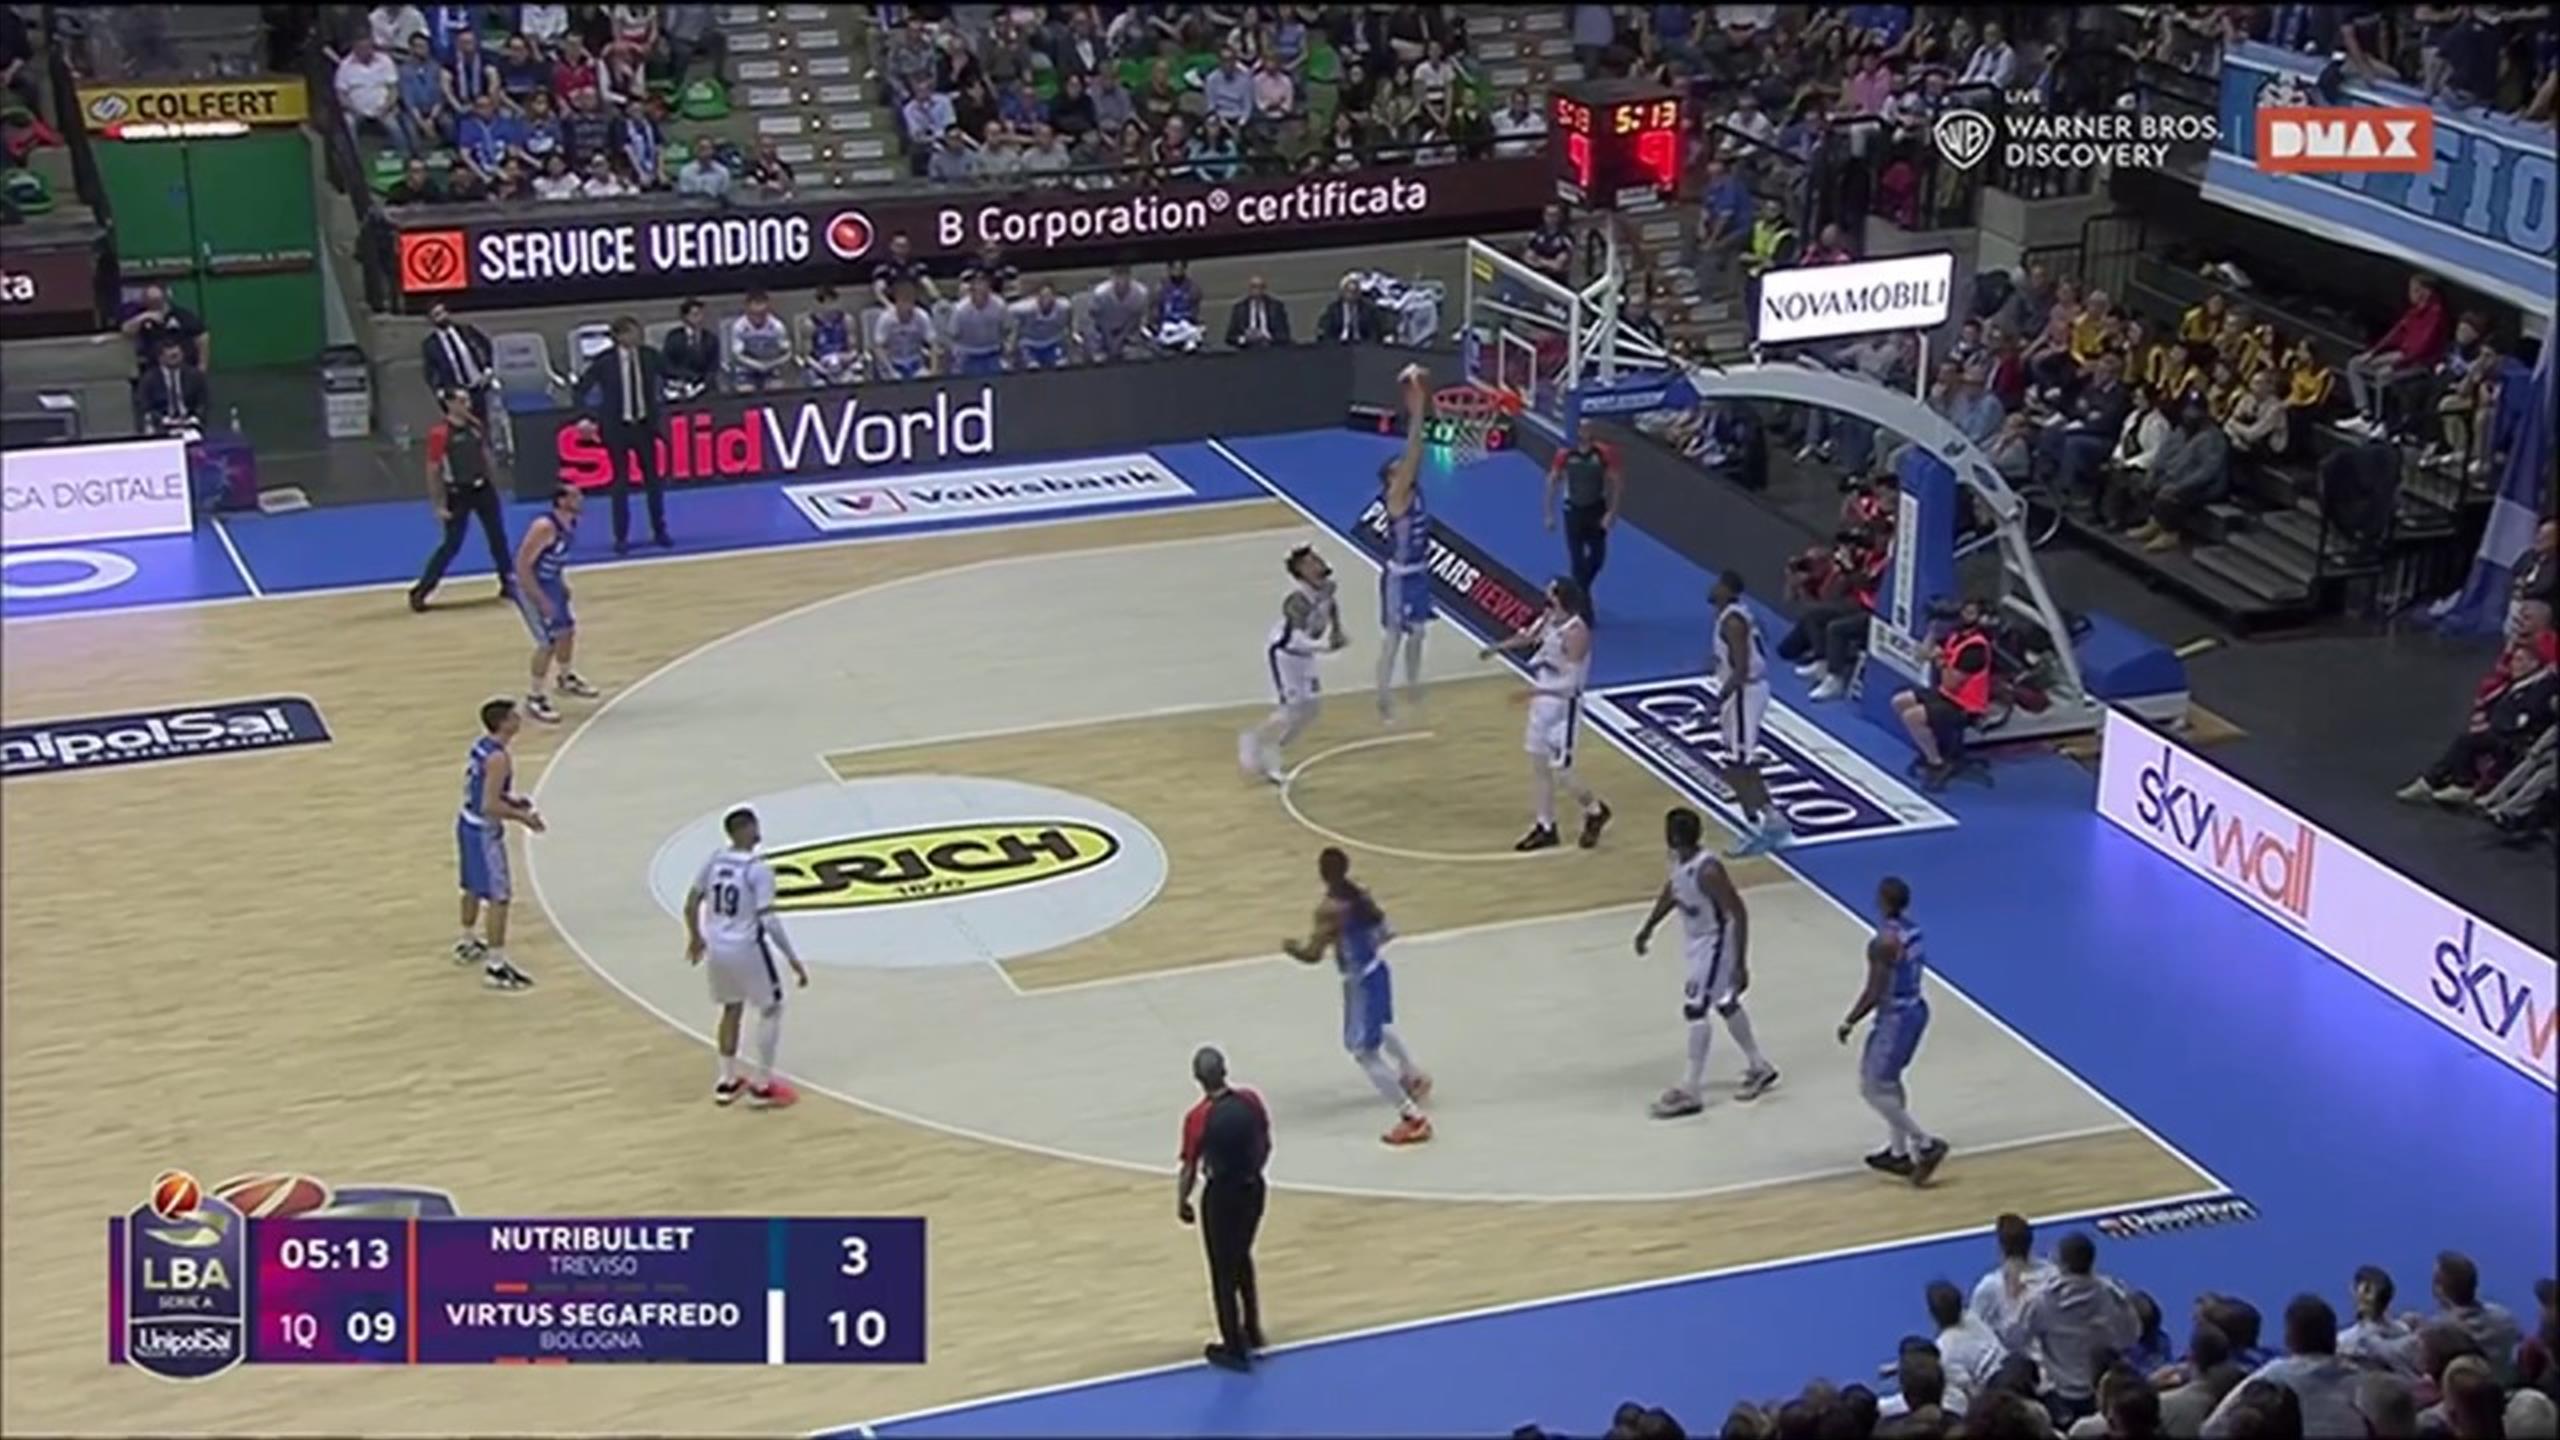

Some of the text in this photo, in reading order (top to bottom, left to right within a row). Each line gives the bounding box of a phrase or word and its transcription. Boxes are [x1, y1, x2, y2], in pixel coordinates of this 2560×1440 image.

[136, 90, 278, 121] COLFERT
[1615, 100, 1677, 134] 5:13
[938, 210, 964, 245] B
[1236, 176, 1428, 224] certificata
[478, 215, 811, 282] SERVICE VENDING
[1765, 278, 1946, 321] NOVAMOBILI
[52, 473, 184, 508] DIGITALE
[910, 466, 1162, 505] Volksbank
[2136, 745, 2317, 920] skywall
[712, 882, 740, 918] 19
